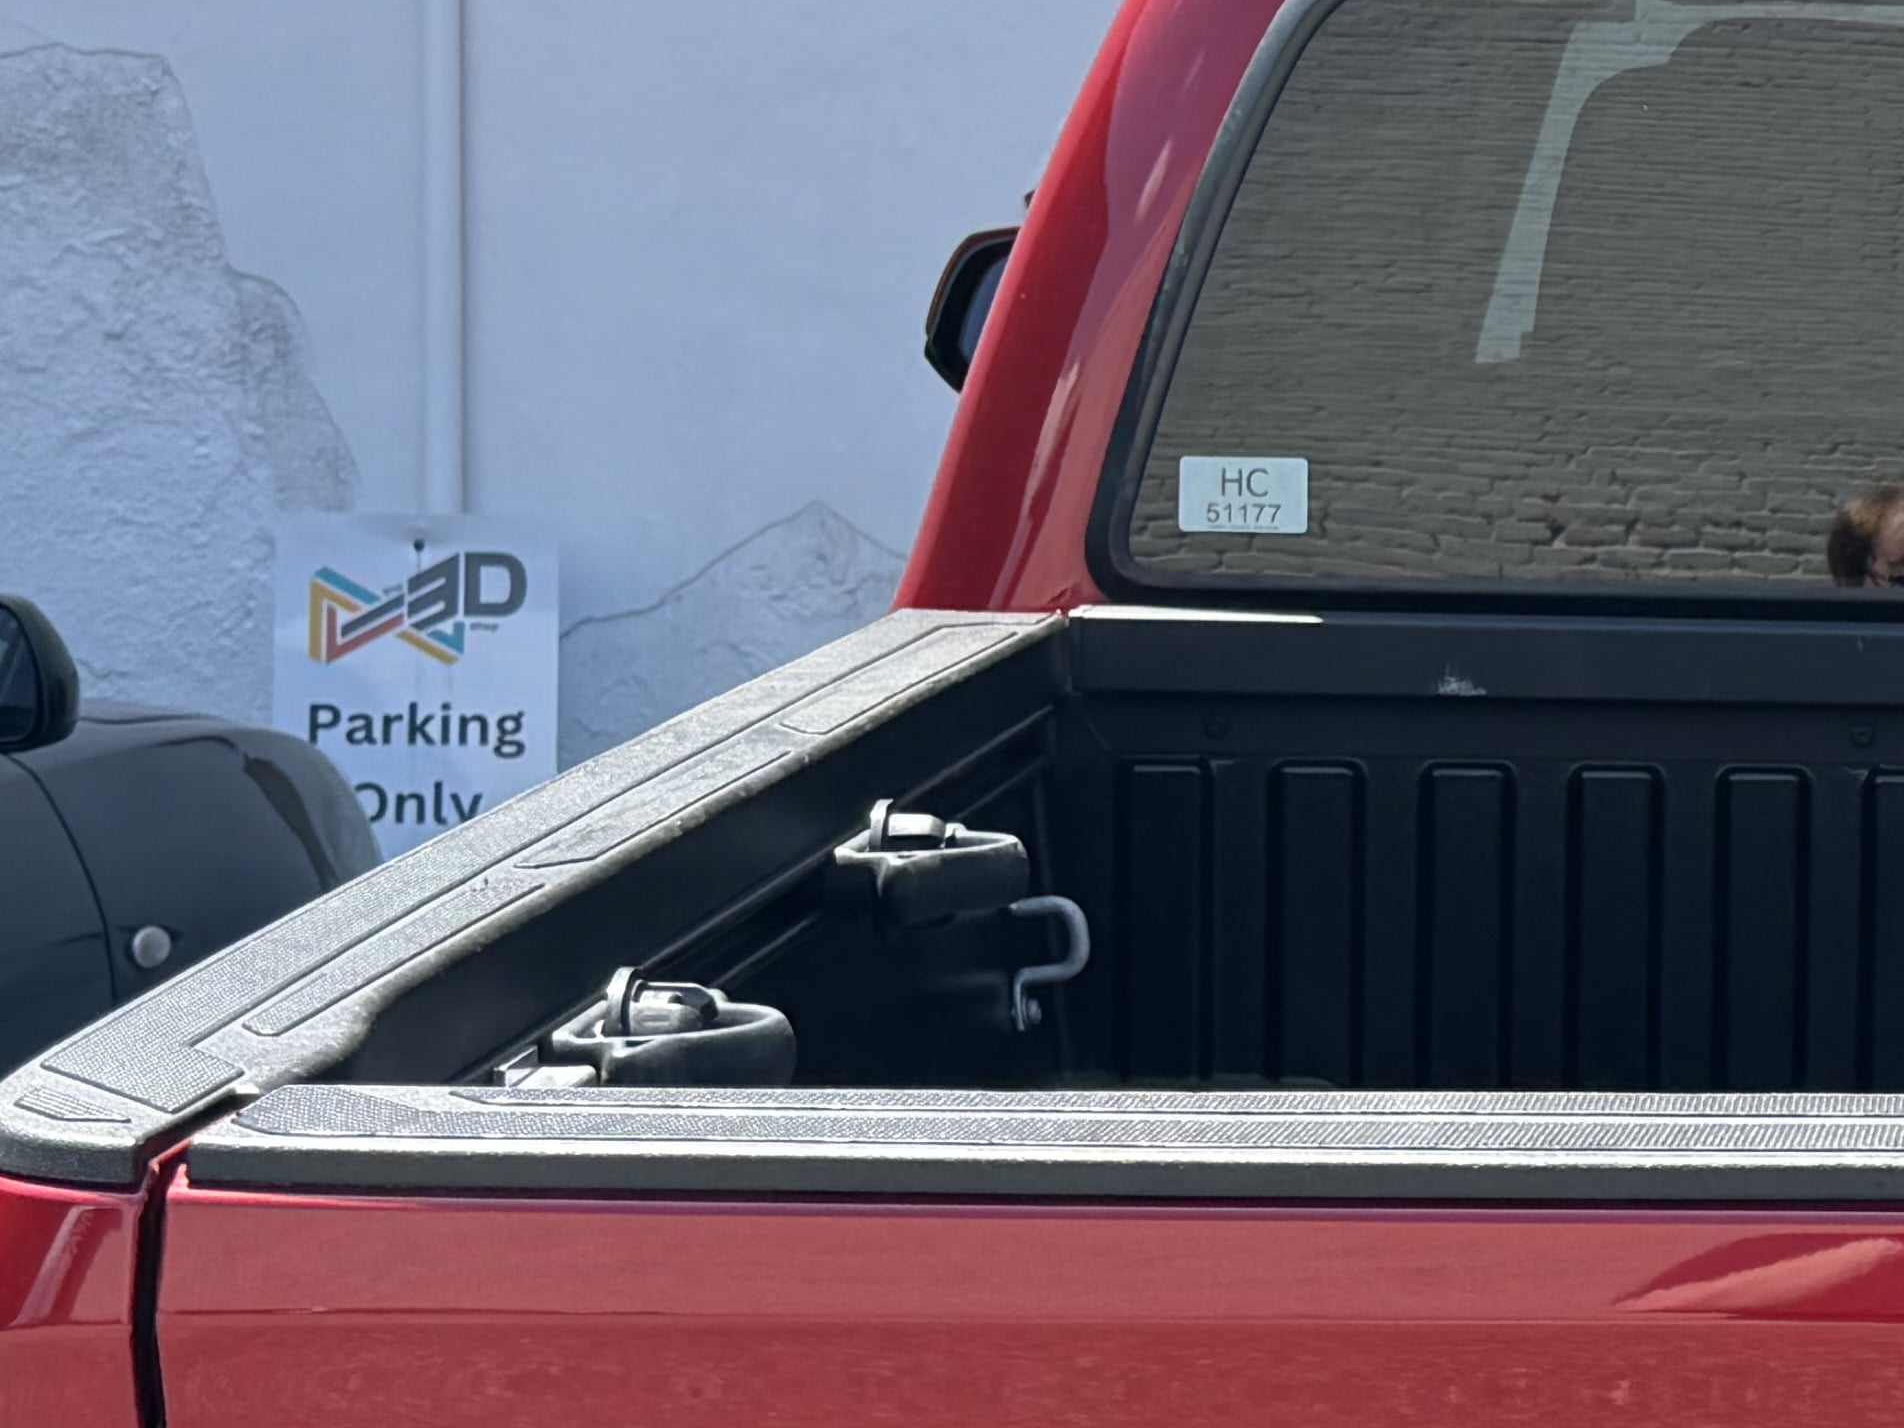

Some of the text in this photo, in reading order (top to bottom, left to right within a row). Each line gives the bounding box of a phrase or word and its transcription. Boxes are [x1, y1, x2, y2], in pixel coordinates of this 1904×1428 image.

[1221, 467, 1269, 498] HC
[1206, 502, 1282, 524] 51177
[307, 701, 526, 759] Parking
